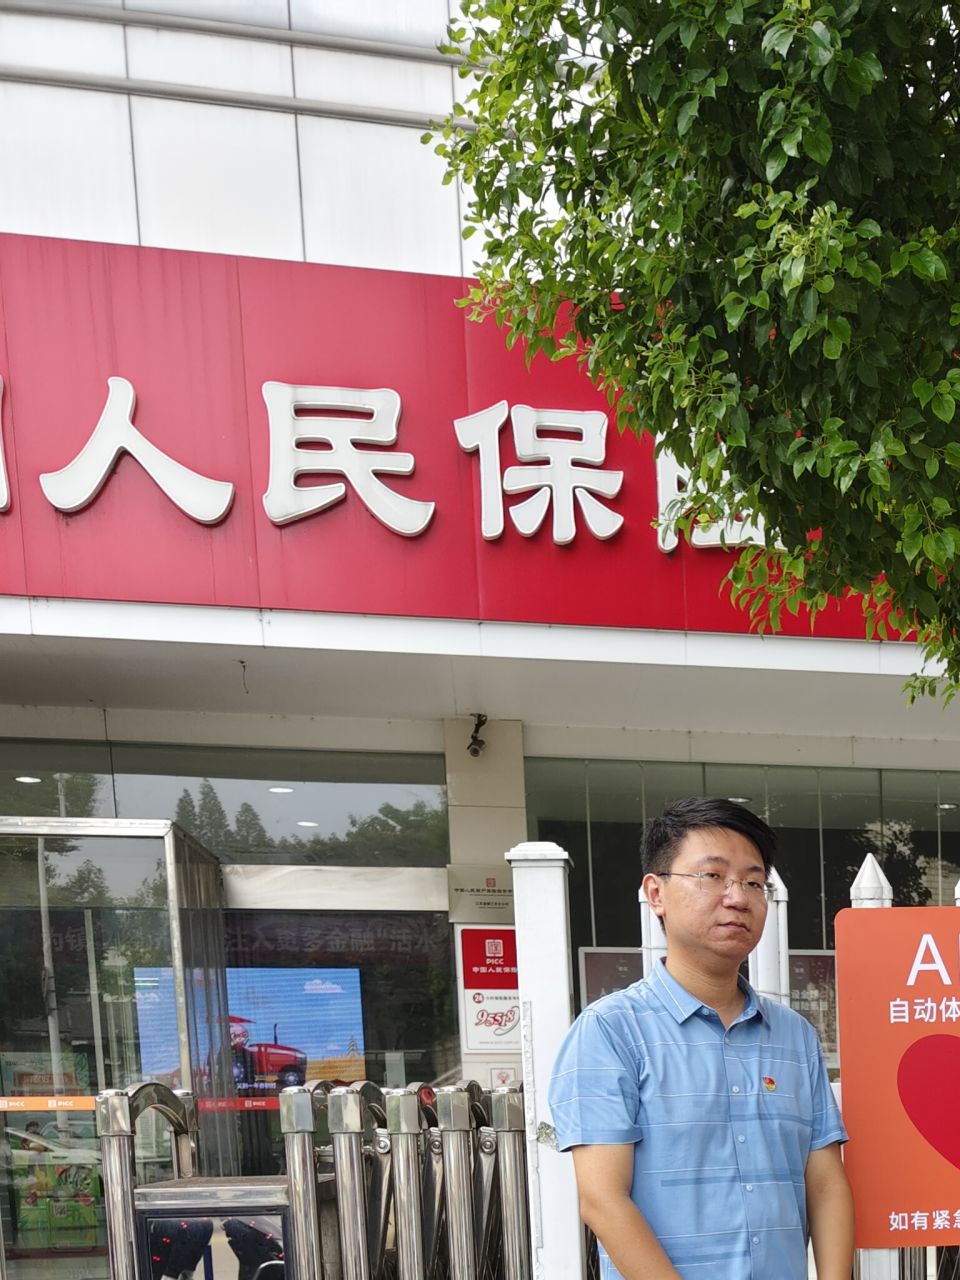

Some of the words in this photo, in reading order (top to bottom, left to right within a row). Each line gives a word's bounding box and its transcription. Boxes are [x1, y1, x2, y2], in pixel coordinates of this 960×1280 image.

[0, 374, 788, 553] 人民保
[475, 1008, 516, 1027] 95518
